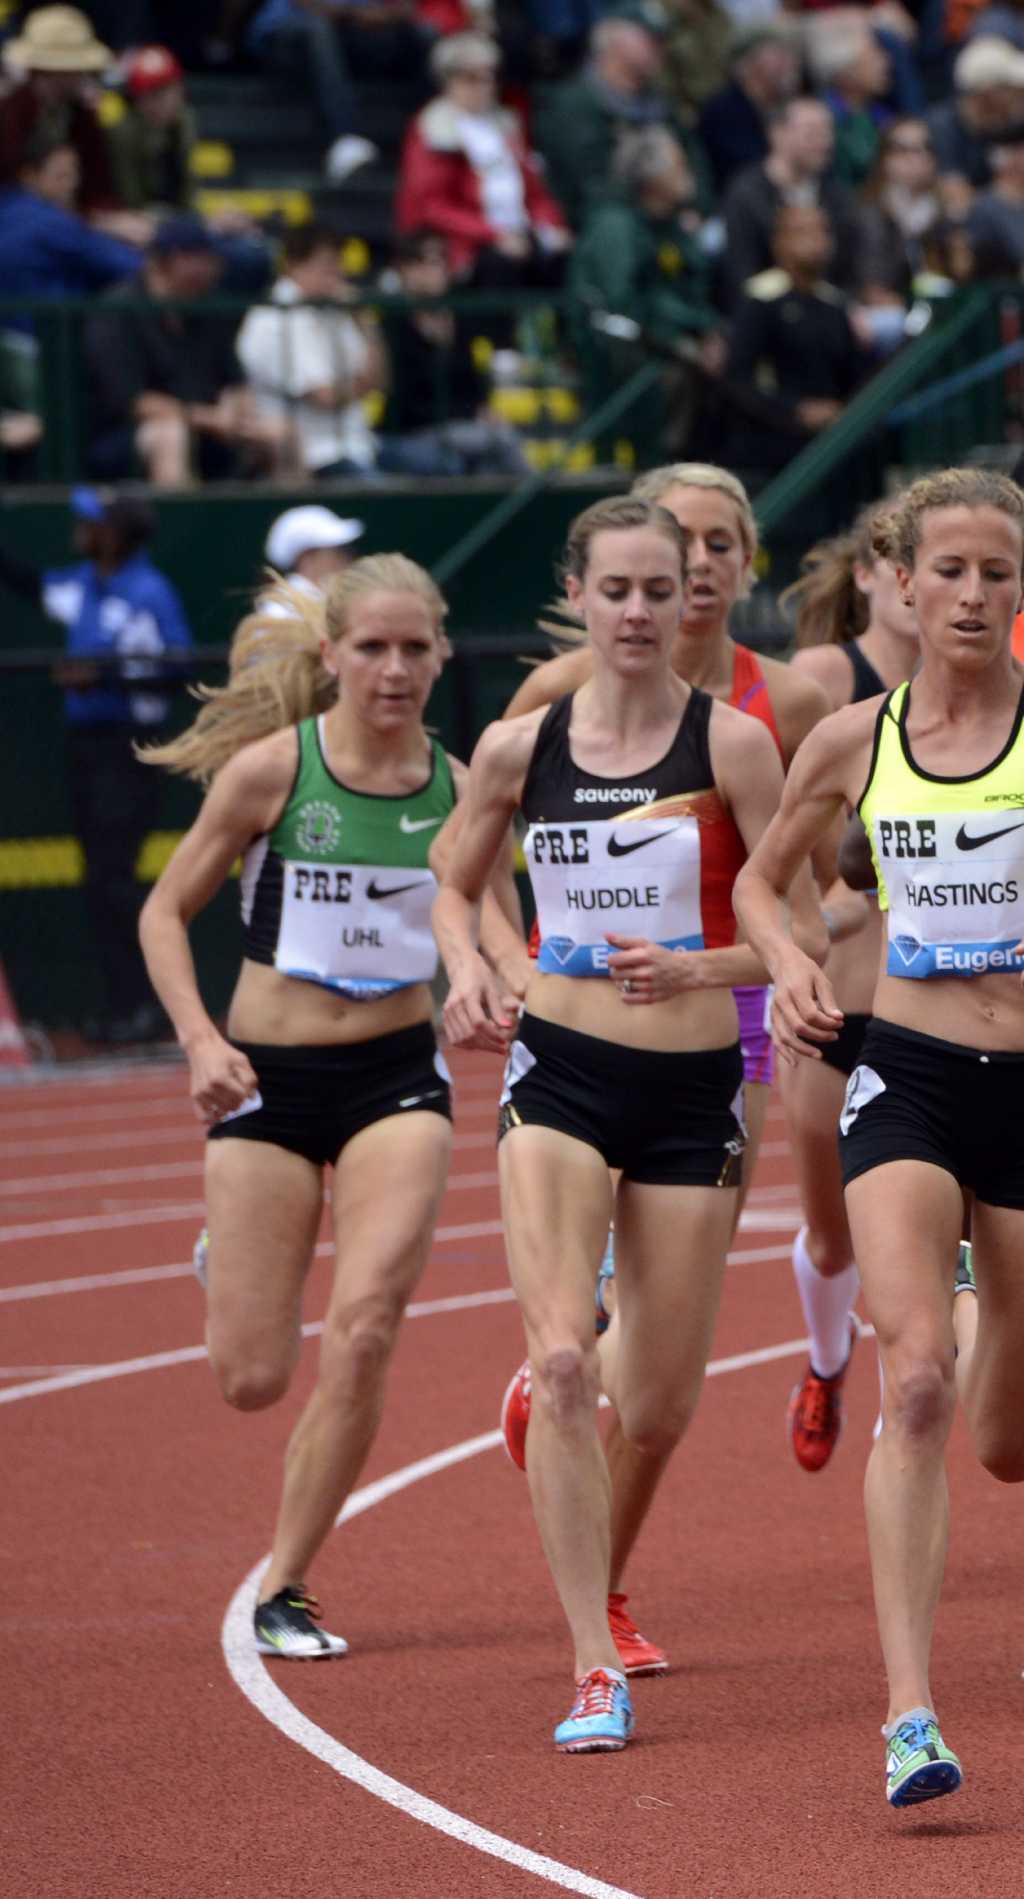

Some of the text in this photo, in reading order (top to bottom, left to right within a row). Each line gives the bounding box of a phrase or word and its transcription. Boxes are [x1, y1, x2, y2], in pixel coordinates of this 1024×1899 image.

[574, 788, 657, 806] saucony
[533, 829, 590, 864] PRE
[879, 820, 937, 858] PRE
[294, 868, 352, 903] PRE
[566, 886, 660, 910] HUDDLE
[906, 880, 1018, 907] HASTINGS
[341, 928, 384, 948] UHL
